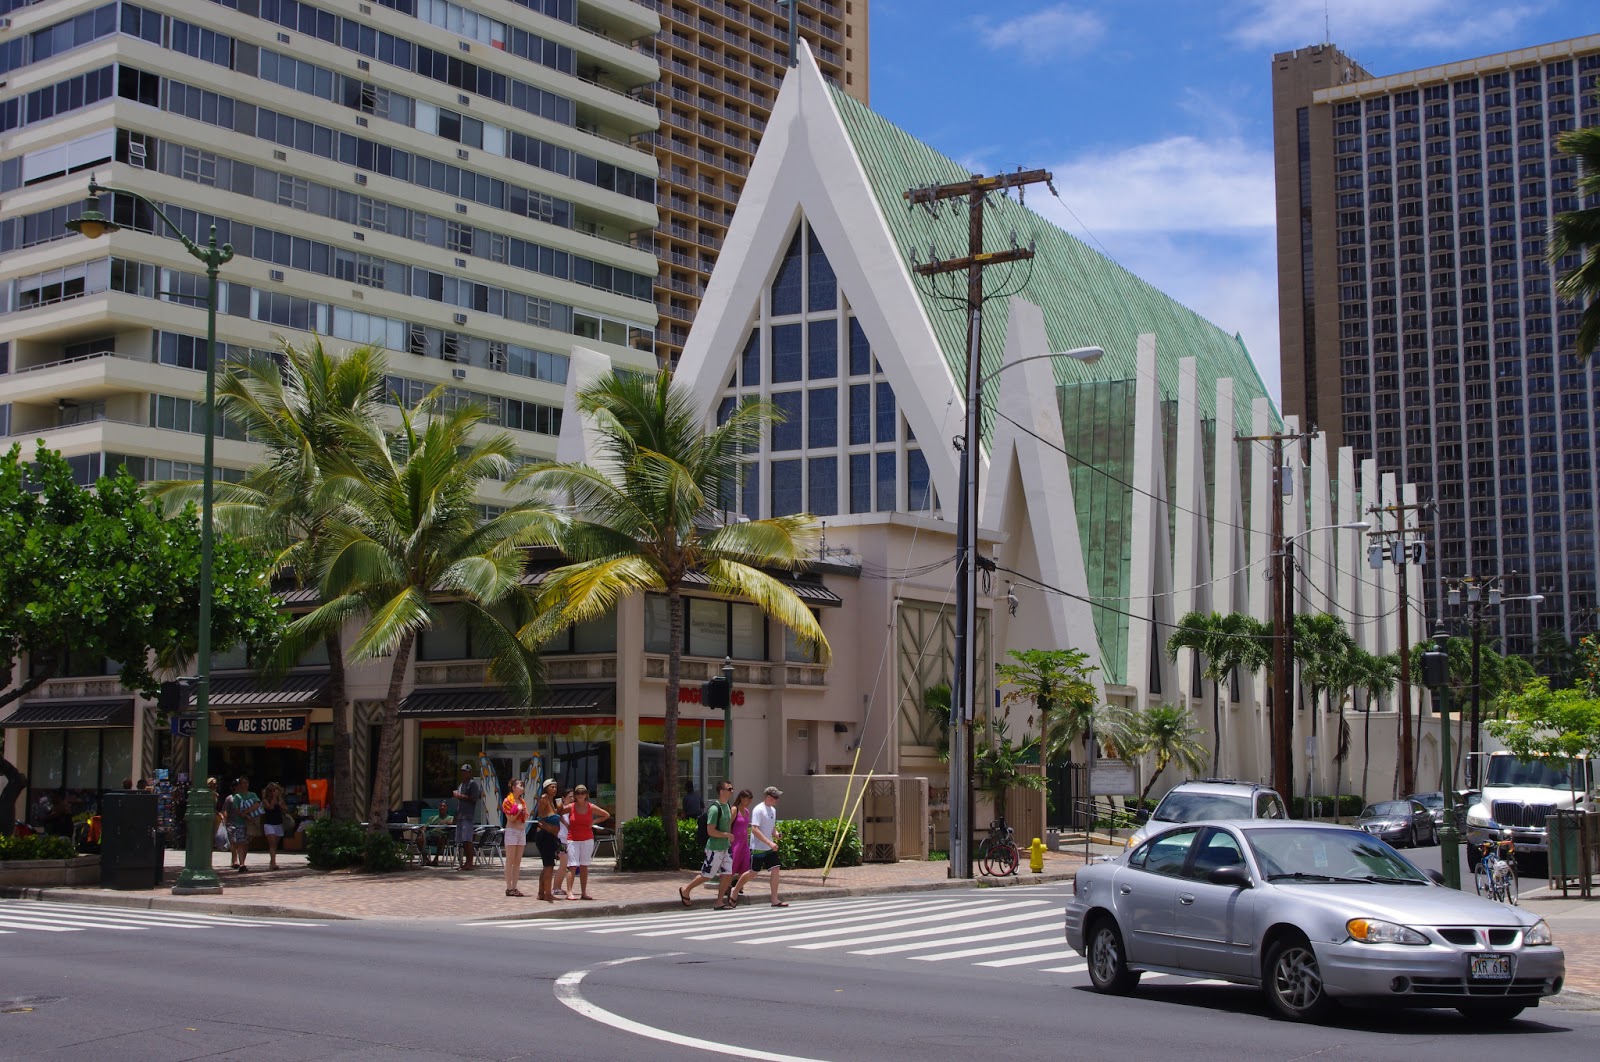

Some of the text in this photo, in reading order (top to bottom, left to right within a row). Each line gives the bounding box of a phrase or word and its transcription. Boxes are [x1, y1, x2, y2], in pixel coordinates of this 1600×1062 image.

[182, 720, 197, 729] AB
[237, 718, 293, 731] ABC STORE
[464, 718, 570, 736] BURGER KING
[1472, 960, 1508, 973] JXR 613
